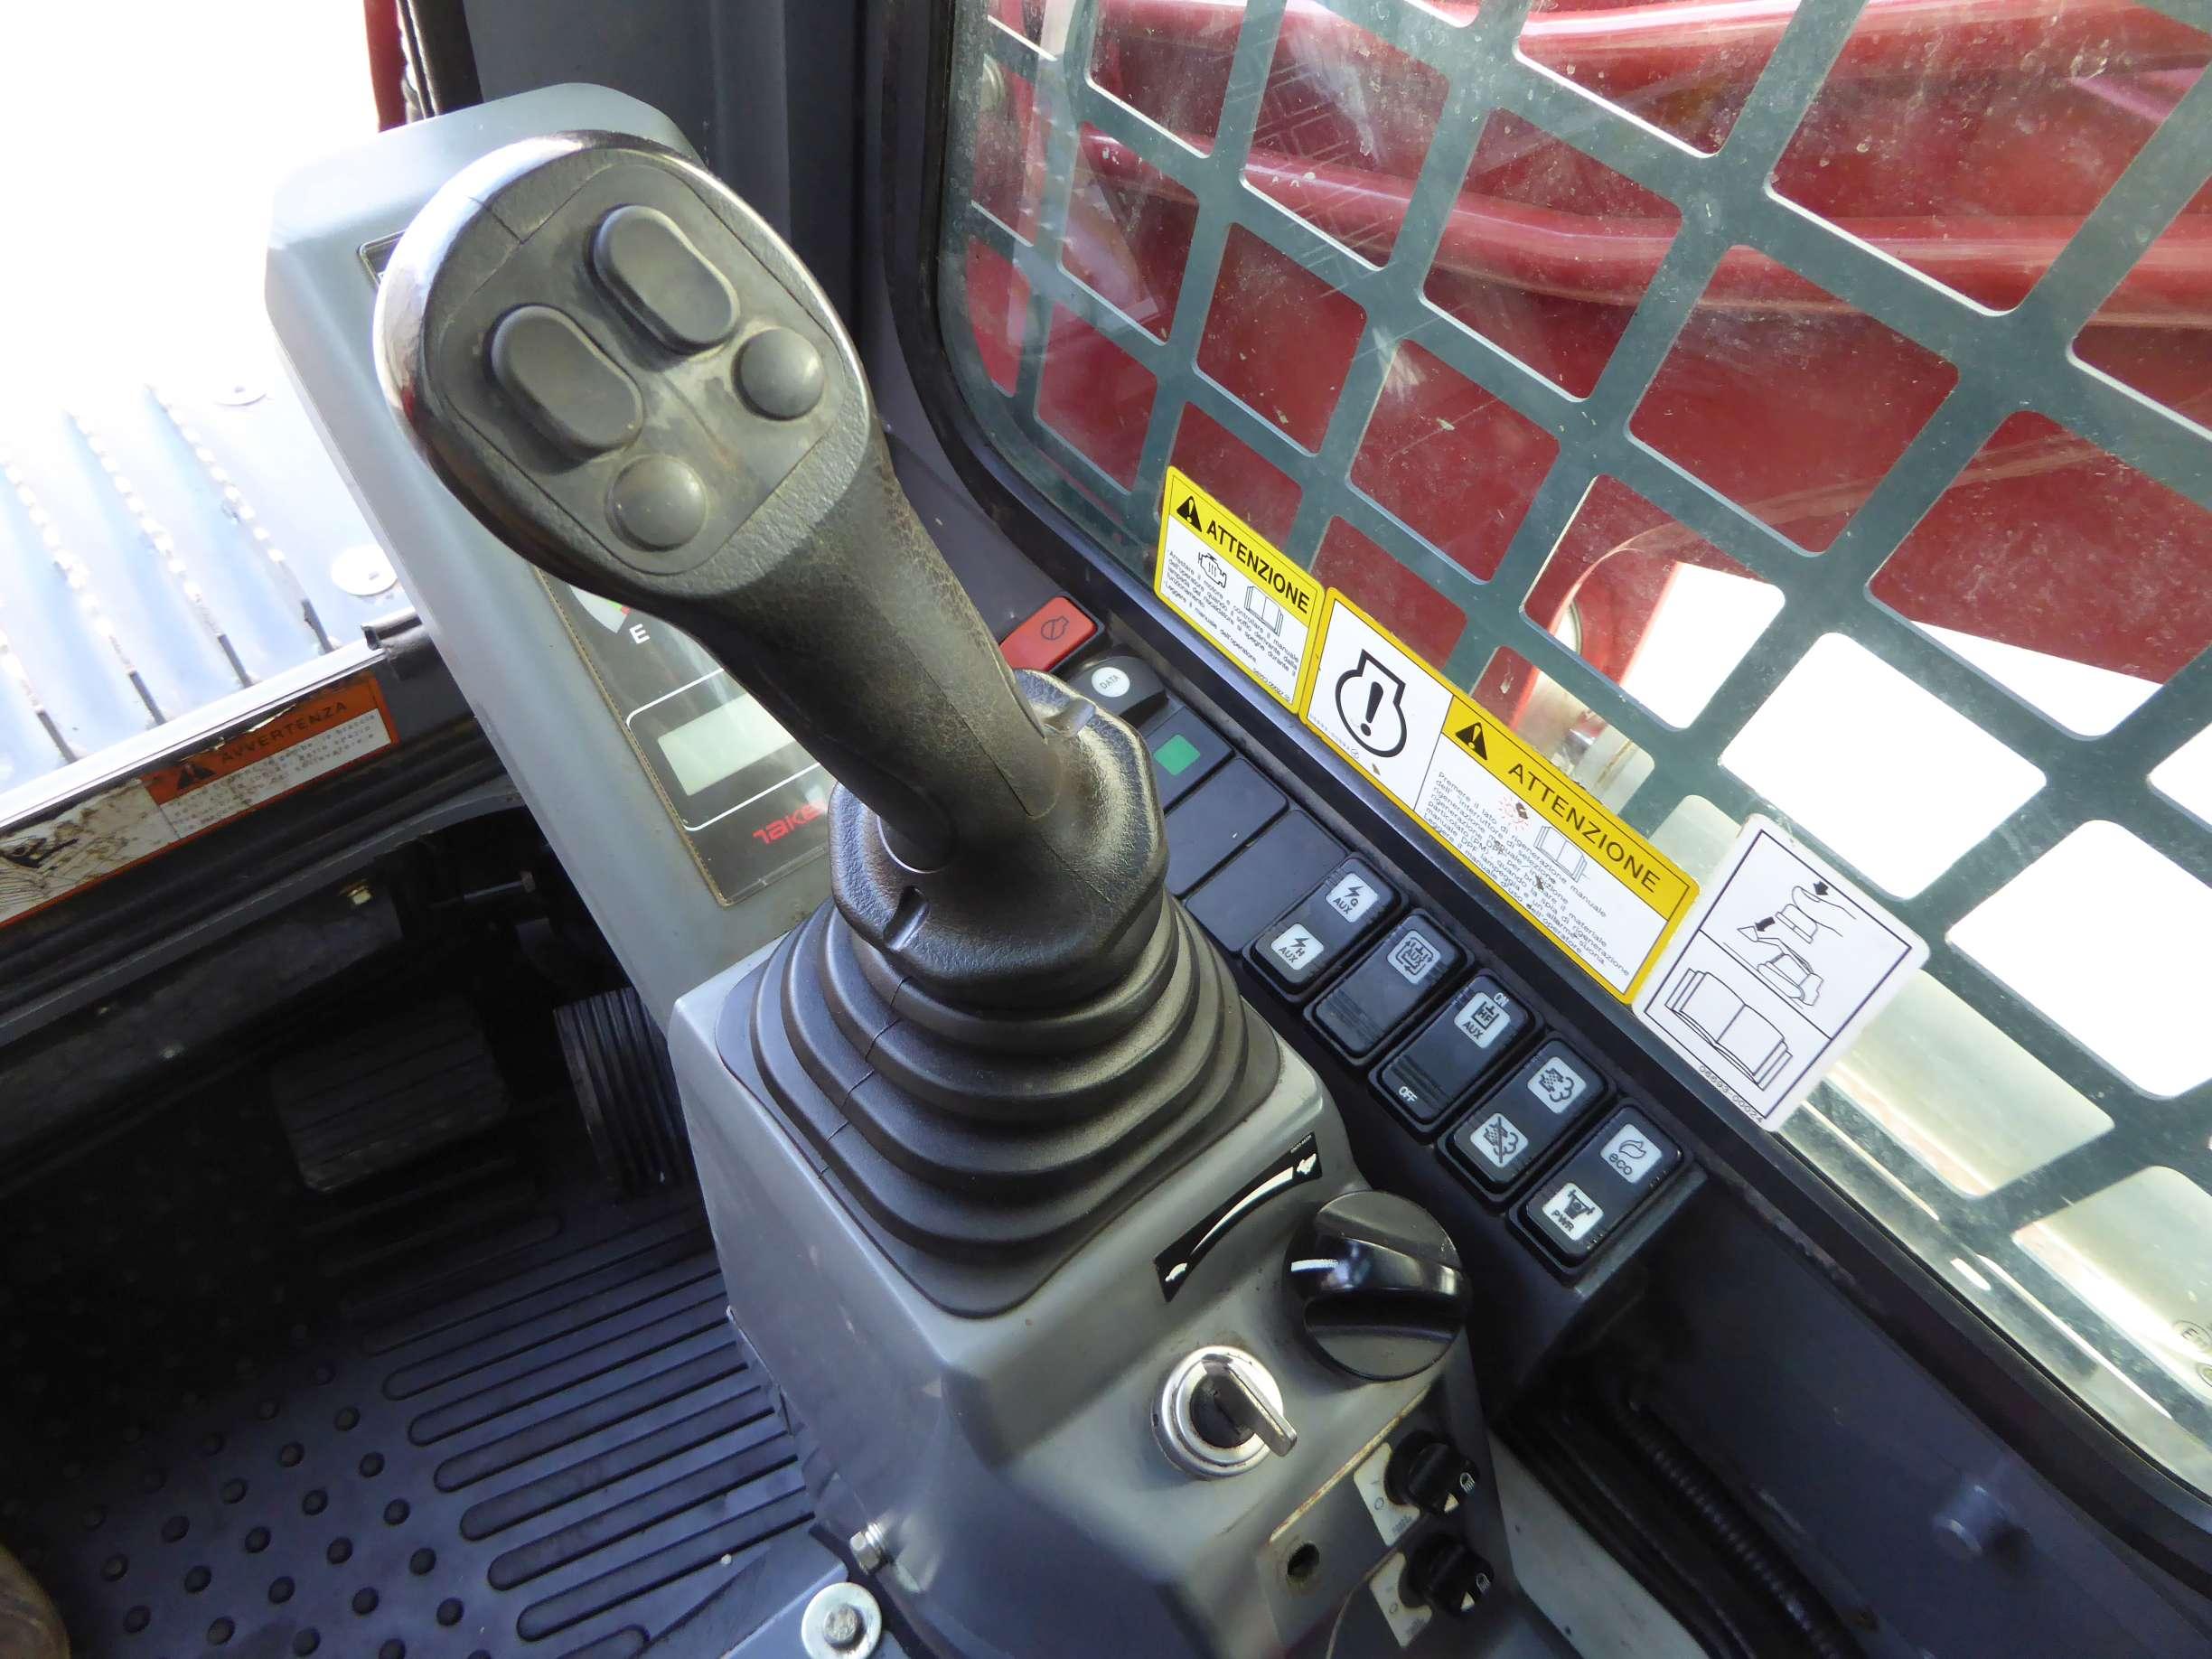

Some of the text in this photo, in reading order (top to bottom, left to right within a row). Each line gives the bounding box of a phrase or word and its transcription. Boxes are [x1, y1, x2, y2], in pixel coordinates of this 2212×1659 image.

[1206, 520, 1309, 614] ATTENZIONE
[629, 623, 650, 644] E
[1099, 674, 1121, 689] DATA
[221, 702, 348, 764] AVVERTENZA
[1432, 784, 1486, 836] rigenerazione
[1507, 763, 1661, 894] ATTENZIONE
[1438, 771, 1471, 803] Premere
[1481, 807, 1498, 825] lato
[1510, 832, 1568, 886] rigenerazione
[1569, 882, 1607, 918] manuale
[1425, 806, 1458, 838] manuale
[1460, 836, 1476, 854] DPF
[1531, 898, 1543, 912] un
[1517, 848, 1557, 885] selezione
[1333, 897, 1353, 914] AUX
[1350, 897, 1359, 907] G
[1506, 859, 1521, 874] per
[1568, 911, 1607, 948] materiale
[1495, 858, 1527, 888] quando
[1570, 923, 1630, 978] rigenerazione
[1278, 947, 1298, 963] AUX
[1296, 947, 1305, 958] H
[1493, 992, 1509, 1008] ON
[1463, 1021, 1484, 1040] AUX
[1399, 1086, 1418, 1103] OFF
[1609, 1153, 1633, 1176] eco
[1551, 1209, 1575, 1233] PWR
